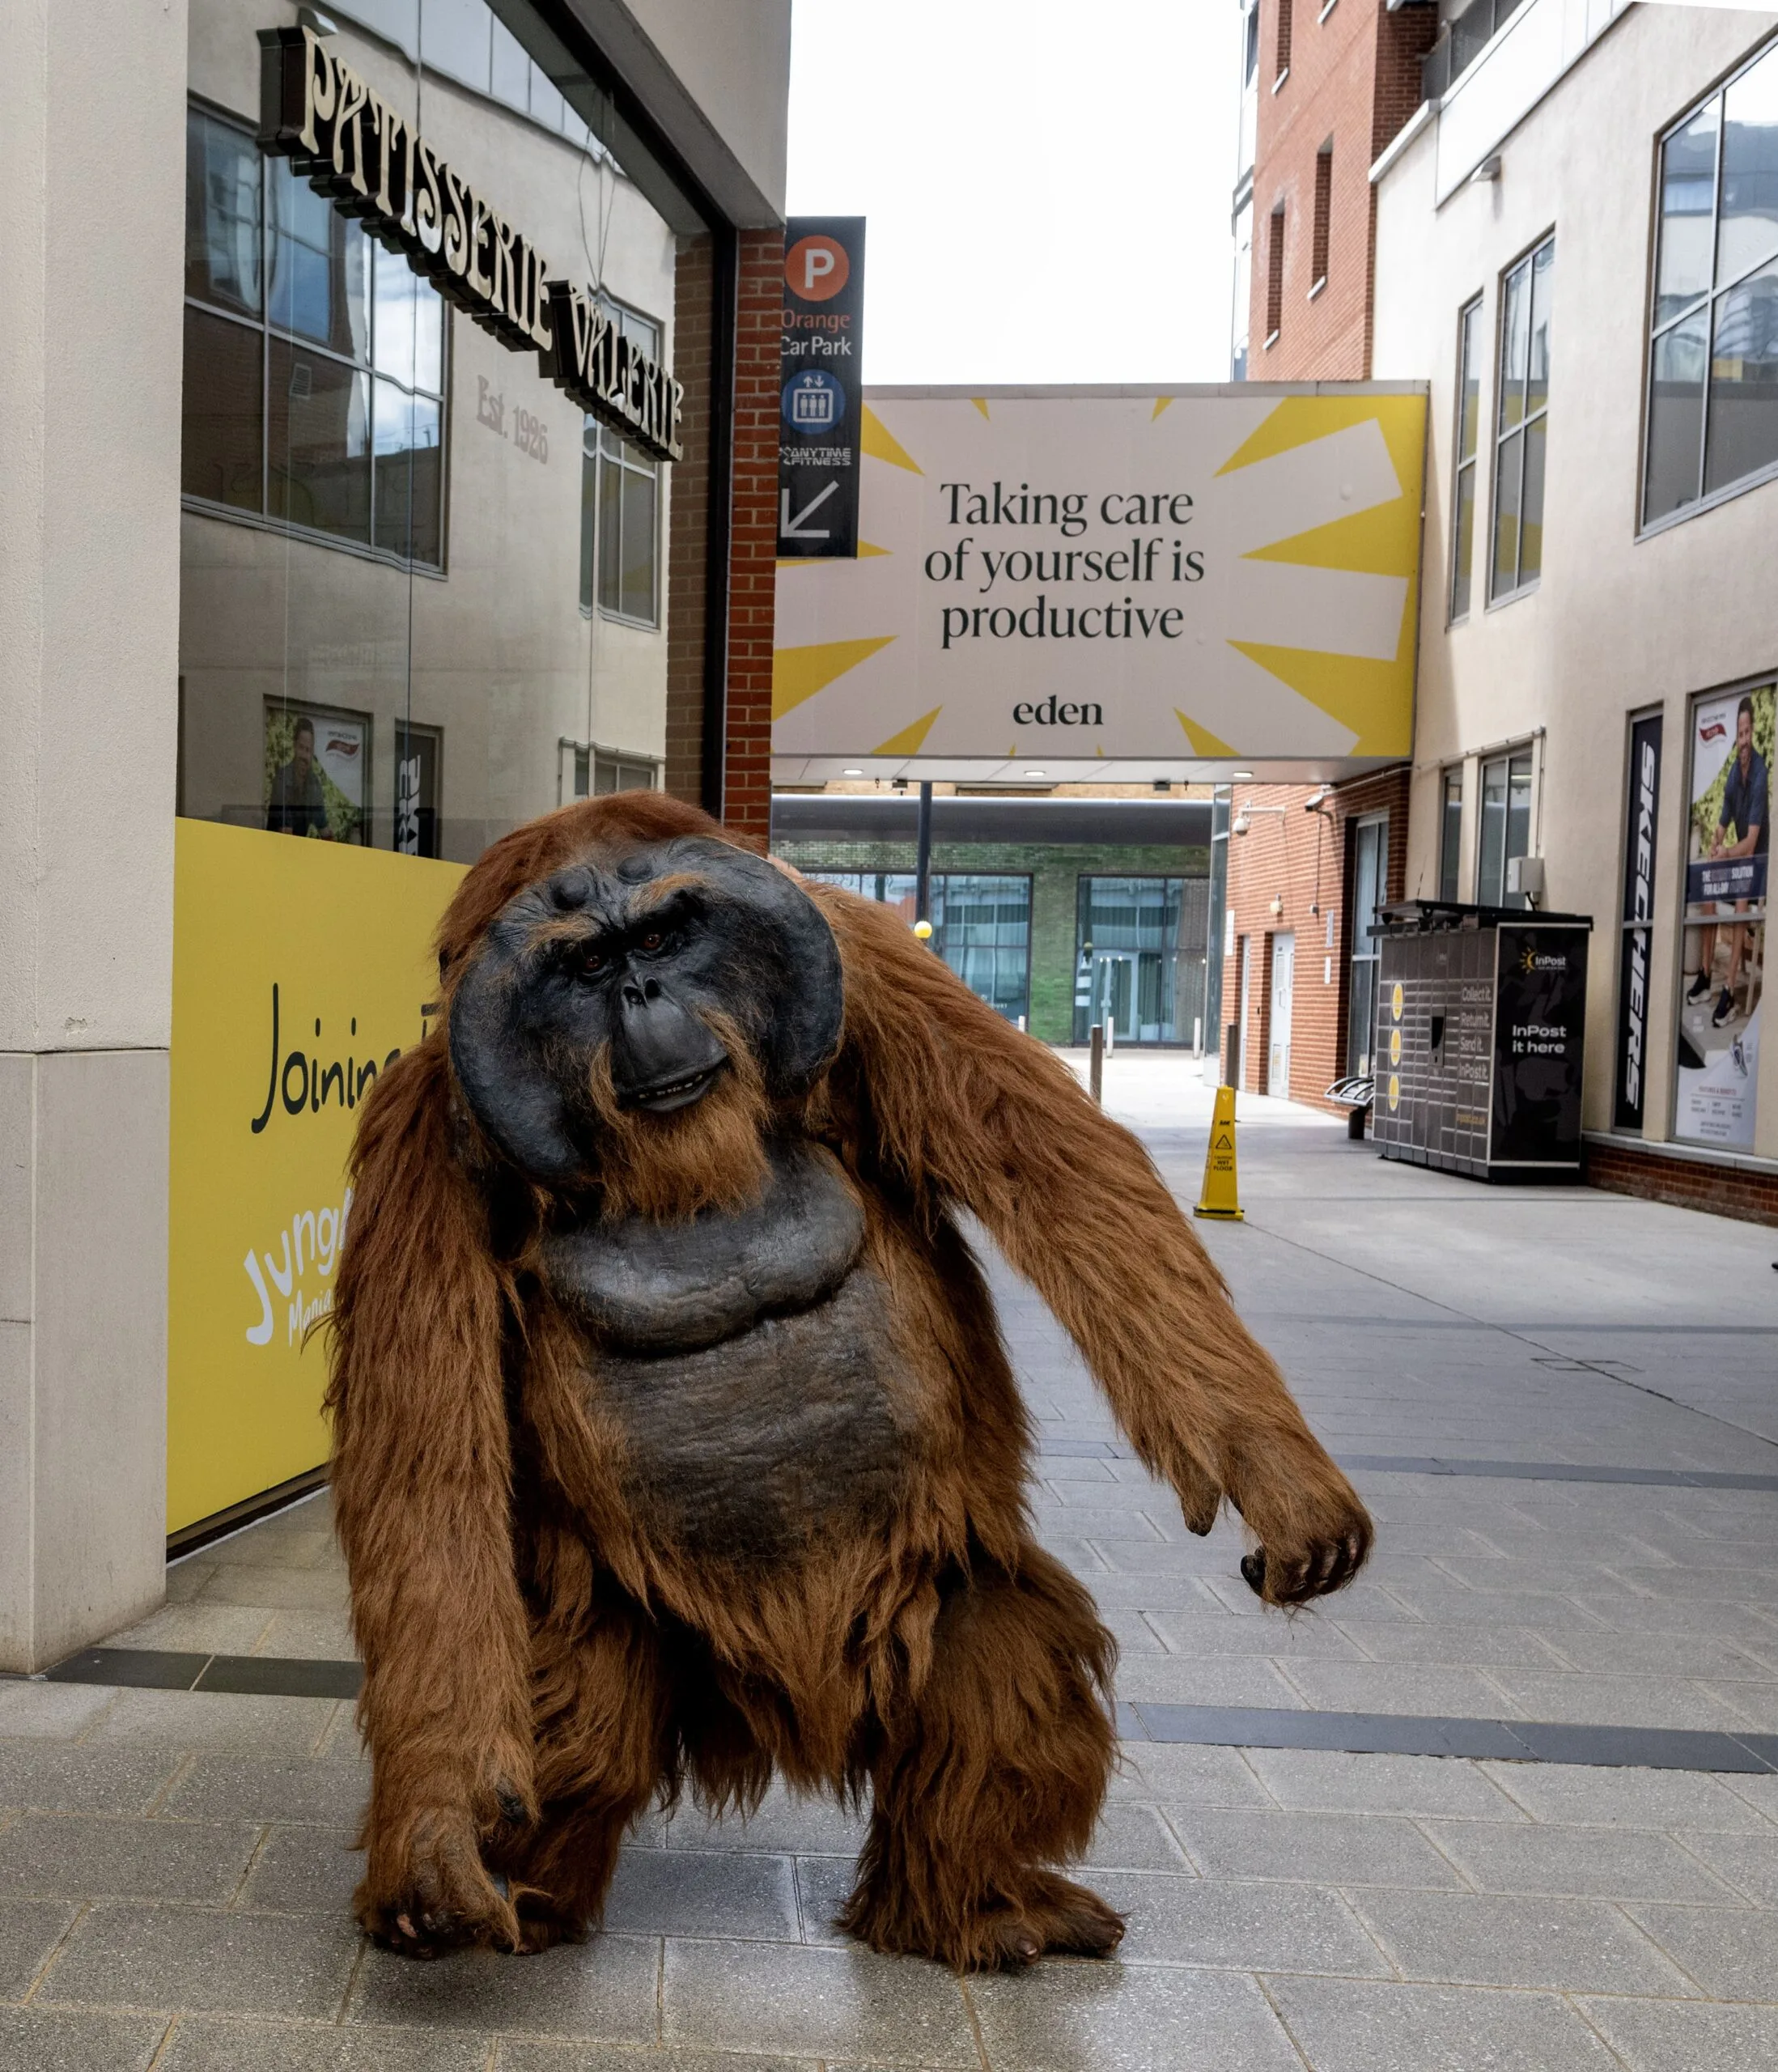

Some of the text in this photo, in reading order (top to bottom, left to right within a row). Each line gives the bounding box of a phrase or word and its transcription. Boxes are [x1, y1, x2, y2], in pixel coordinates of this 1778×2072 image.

[300, 24, 684, 461] PATISSERIE VALERIE
[804, 248, 834, 288] P
[781, 309, 851, 333] Orange
[780, 336, 852, 355] Car Park
[477, 375, 548, 465] Est. 1926
[791, 448, 851, 457] ANYTIME
[791, 457, 851, 465] FITNESS
[940, 482, 1194, 537] Taking care
[925, 537, 1204, 592] of yourself is
[941, 595, 1184, 649] productive
[1012, 694, 1104, 725] eden
[1626, 740, 1654, 1110] SKECHERS
[1535, 956, 1567, 966] InPost
[1460, 1037, 1476, 1051] Send
[1512, 1025, 1568, 1037] InPost
[1512, 1039, 1565, 1053] it here
